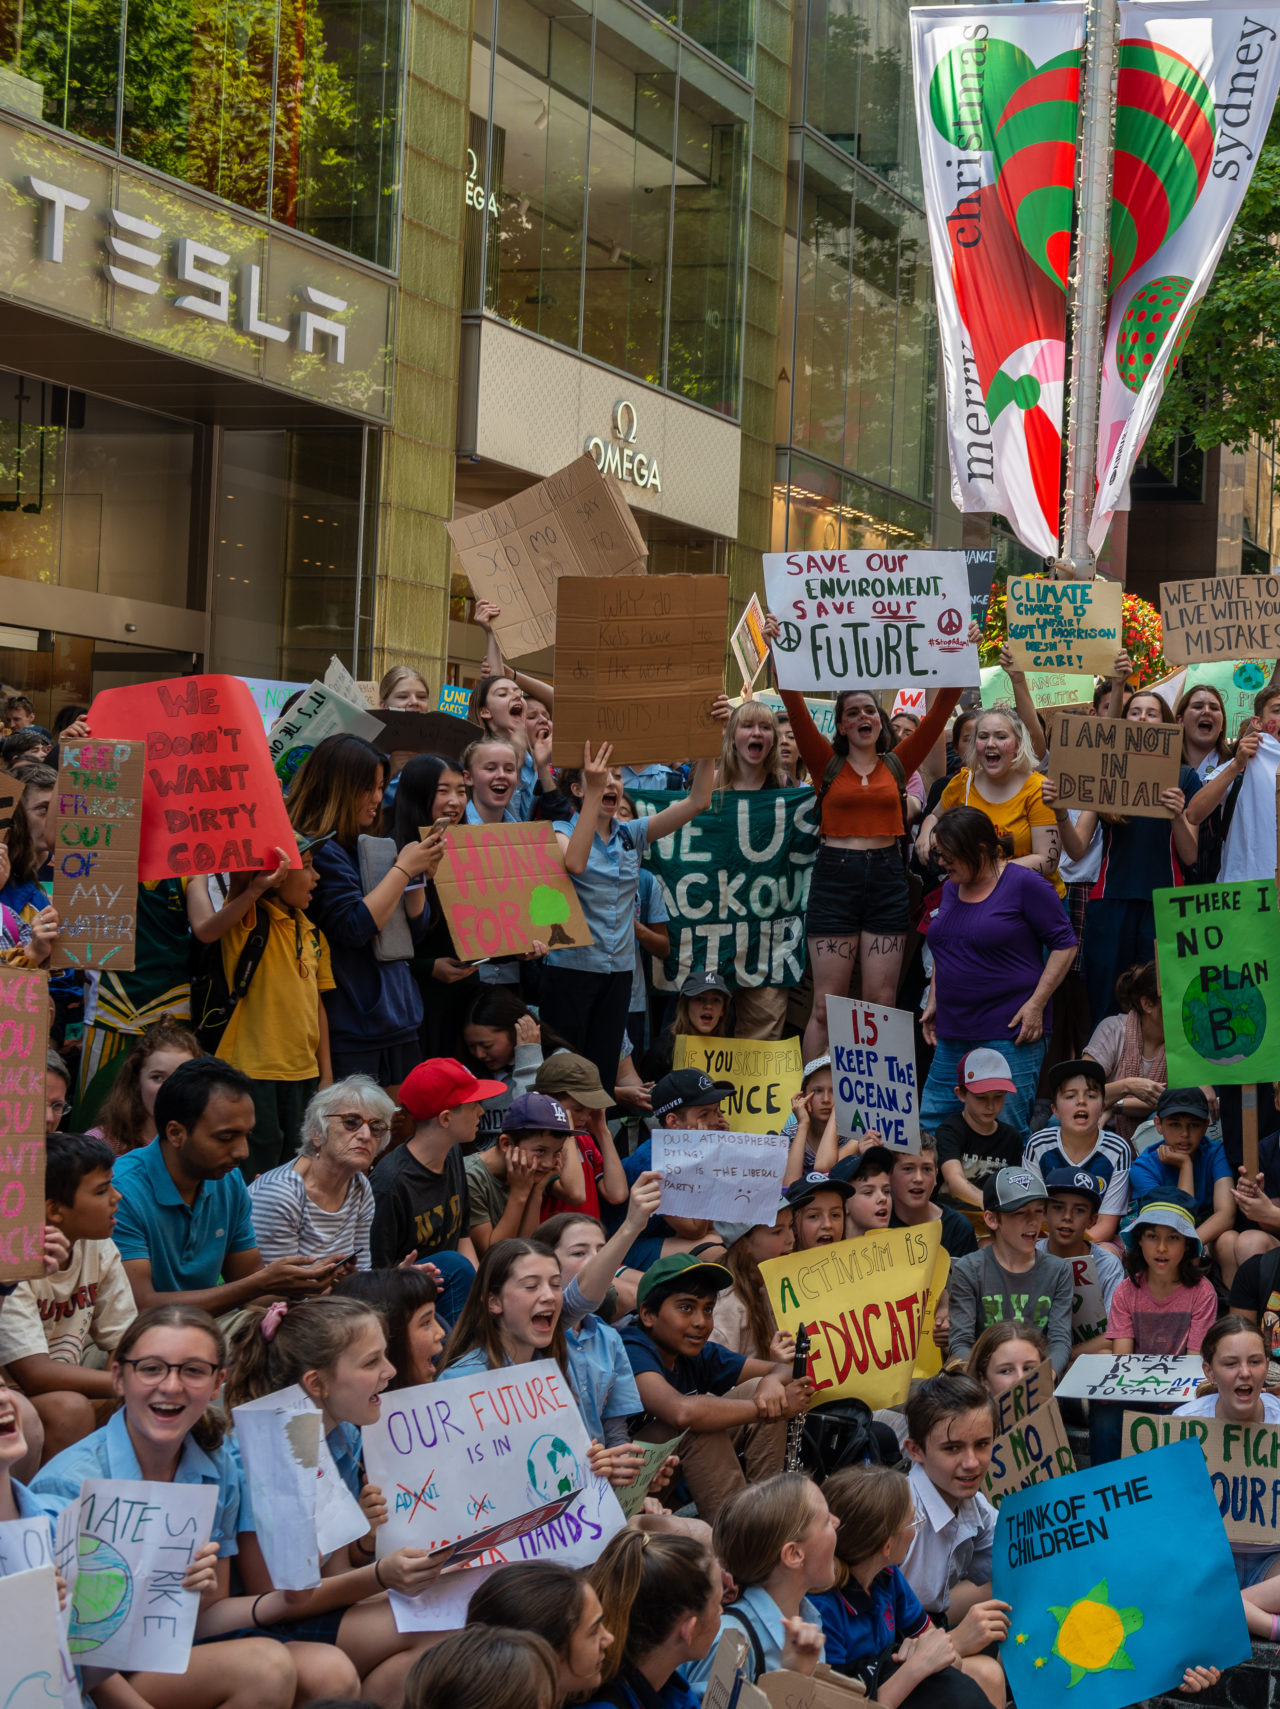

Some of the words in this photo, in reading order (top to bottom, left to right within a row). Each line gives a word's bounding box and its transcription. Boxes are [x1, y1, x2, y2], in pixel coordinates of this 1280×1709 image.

[1212, 15, 1277, 182] sydney
[946, 22, 989, 249] christmas
[23, 176, 348, 365] TESLA
[961, 340, 994, 484] merry
[585, 436, 662, 492] OMEGA
[786, 553, 850, 576] SAVE
[866, 553, 908, 573] OUr
[805, 576, 947, 600] ENVIROMENT,
[1010, 580, 1093, 604] CLIMATE
[1164, 583, 1196, 606] WE
[1202, 578, 1249, 601] HAVE
[1256, 577, 1279, 598] TO
[792, 600, 856, 620] SAVE
[1016, 602, 1063, 618] CHANGE
[1073, 604, 1086, 617] IS
[1165, 603, 1208, 632] LIVE
[1210, 600, 1254, 624] WITH
[1008, 622, 1049, 640] SCOTT
[1051, 628, 1116, 640] MORRISON
[811, 622, 938, 681] FUTURE.
[1033, 655, 1084, 670] CARE!
[157, 681, 220, 718] WE
[440, 702, 463, 714] CARES
[147, 726, 241, 760] DON'T
[1060, 719, 1070, 746] I
[1076, 723, 1116, 749] AM
[1125, 727, 1180, 756] NOT
[62, 745, 131, 770] KEEP
[1101, 752, 1128, 779] IN
[67, 770, 120, 793] THE
[149, 764, 249, 797] WANT
[1059, 772, 1163, 806] DENIAL
[59, 794, 135, 818] FRACK
[164, 802, 257, 834] DiRTY
[60, 822, 120, 847] OUT
[61, 852, 100, 879] OF
[167, 839, 265, 873] COAL
[445, 827, 570, 899] HONK
[69, 882, 124, 908] MY
[1169, 890, 1242, 918] THERE
[58, 914, 134, 941] WATER
[451, 900, 529, 956] FOR
[1176, 926, 1224, 958] NO
[1208, 1007, 1237, 1051] B
[704, 1050, 734, 1073] YOU
[834, 1045, 879, 1077] KEEP
[839, 1077, 912, 1114] OCEANS
[663, 1133, 692, 1145] OUR
[700, 1134, 776, 1146] ATMOSPHERE
[851, 1109, 908, 1146] ALiVE
[664, 1181, 702, 1193] PARTY!
[666, 1164, 681, 1175] SO
[713, 1168, 737, 1177] THE
[743, 1168, 778, 1178] LIBERAL
[981, 1293, 1051, 1328] NYC
[1120, 1387, 1190, 1397] SAVE!
[387, 1400, 466, 1455] OUR
[469, 1375, 569, 1431] FUTURE
[466, 1443, 485, 1464] IS
[492, 1435, 512, 1457] IN
[1006, 1502, 1055, 1542] THINK
[1053, 1496, 1086, 1523] OF
[1092, 1476, 1153, 1512] THE
[518, 1504, 603, 1560] HANDS
[1008, 1517, 1109, 1569] CHILDREN
[143, 1512, 197, 1638] STRIKE
